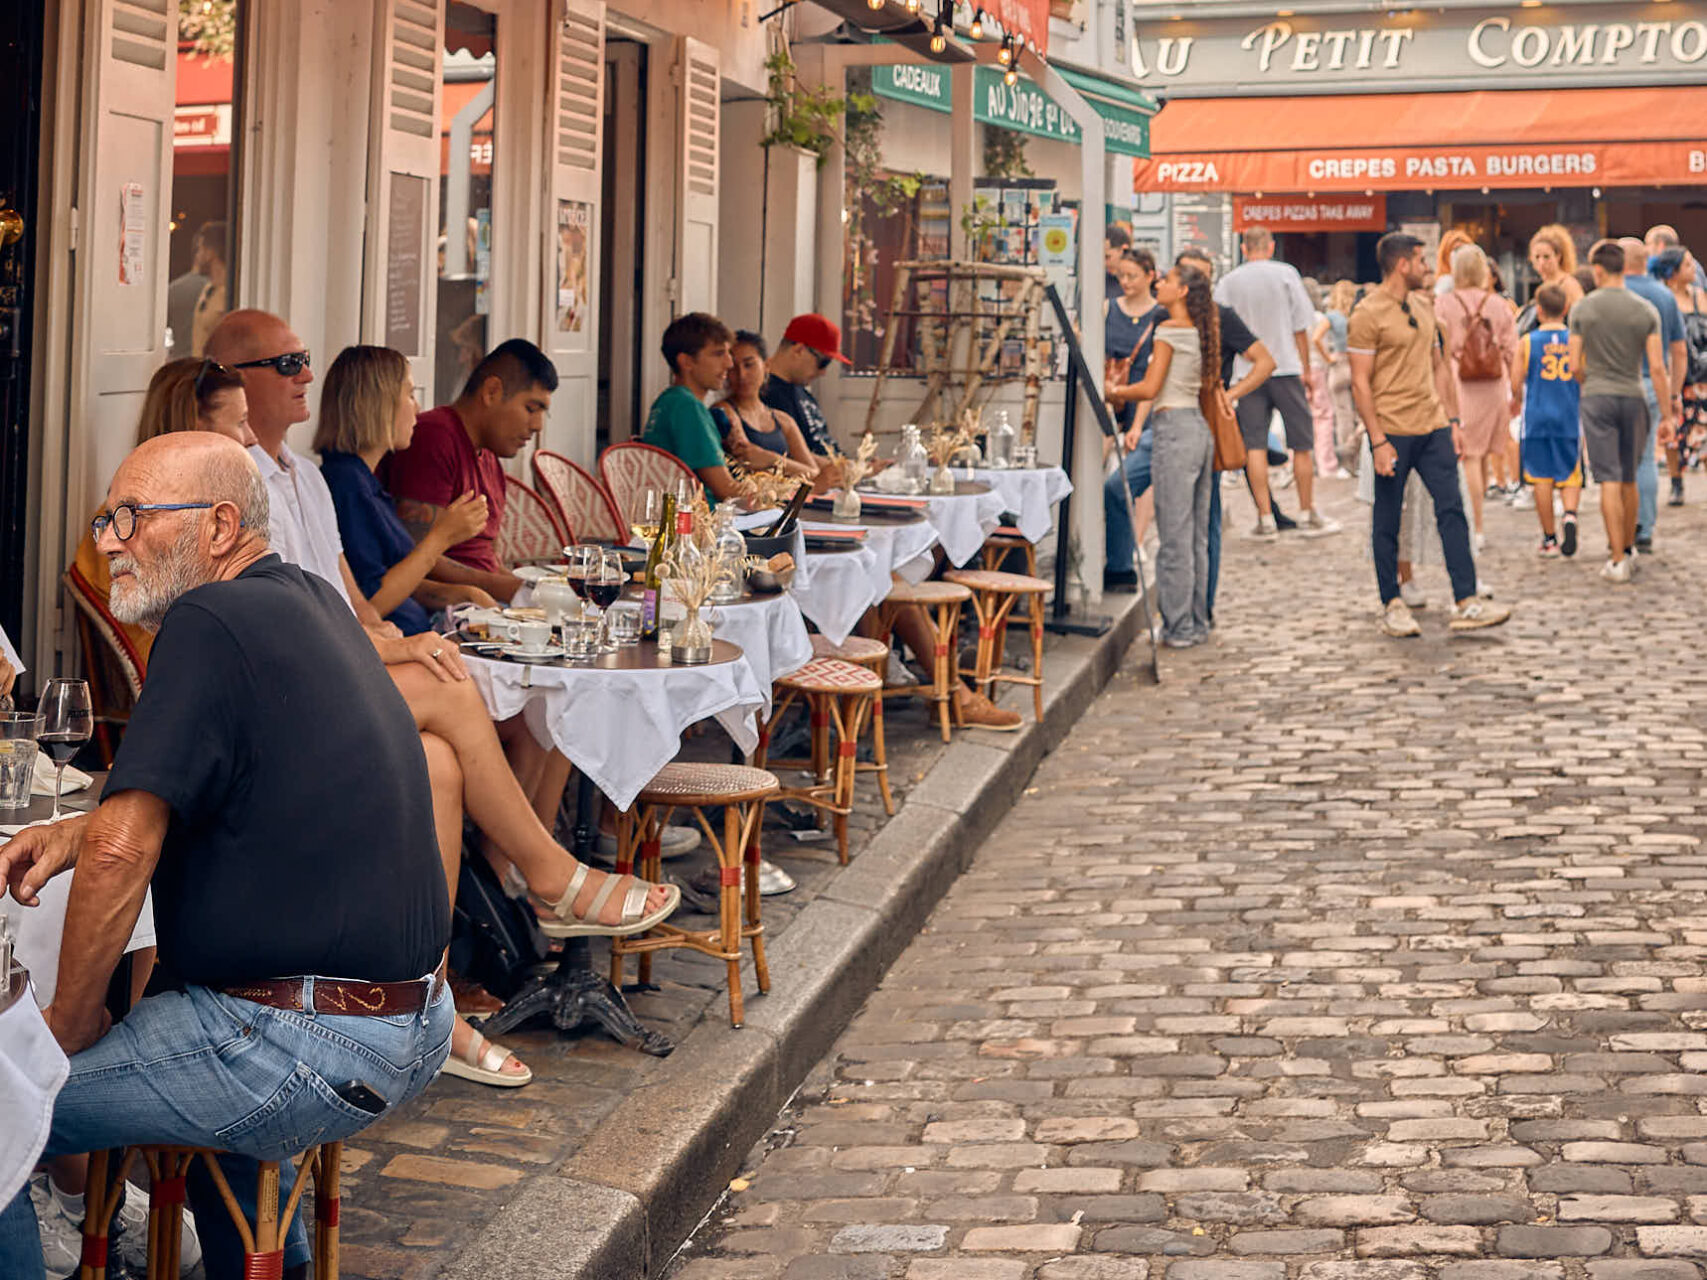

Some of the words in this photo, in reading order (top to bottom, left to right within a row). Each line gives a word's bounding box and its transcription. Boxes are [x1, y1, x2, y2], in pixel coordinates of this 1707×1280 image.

[1241, 22, 1413, 71] PETIT
[1468, 17, 1707, 68] COMPTO
[893, 64, 941, 98] CADEAUX
[1157, 161, 1219, 183] PIZZA
[1309, 158, 1396, 179] CREPES
[1406, 156, 1476, 177] PASTA
[1486, 153, 1596, 176] BURGERS
[1540, 354, 1573, 381] 30
